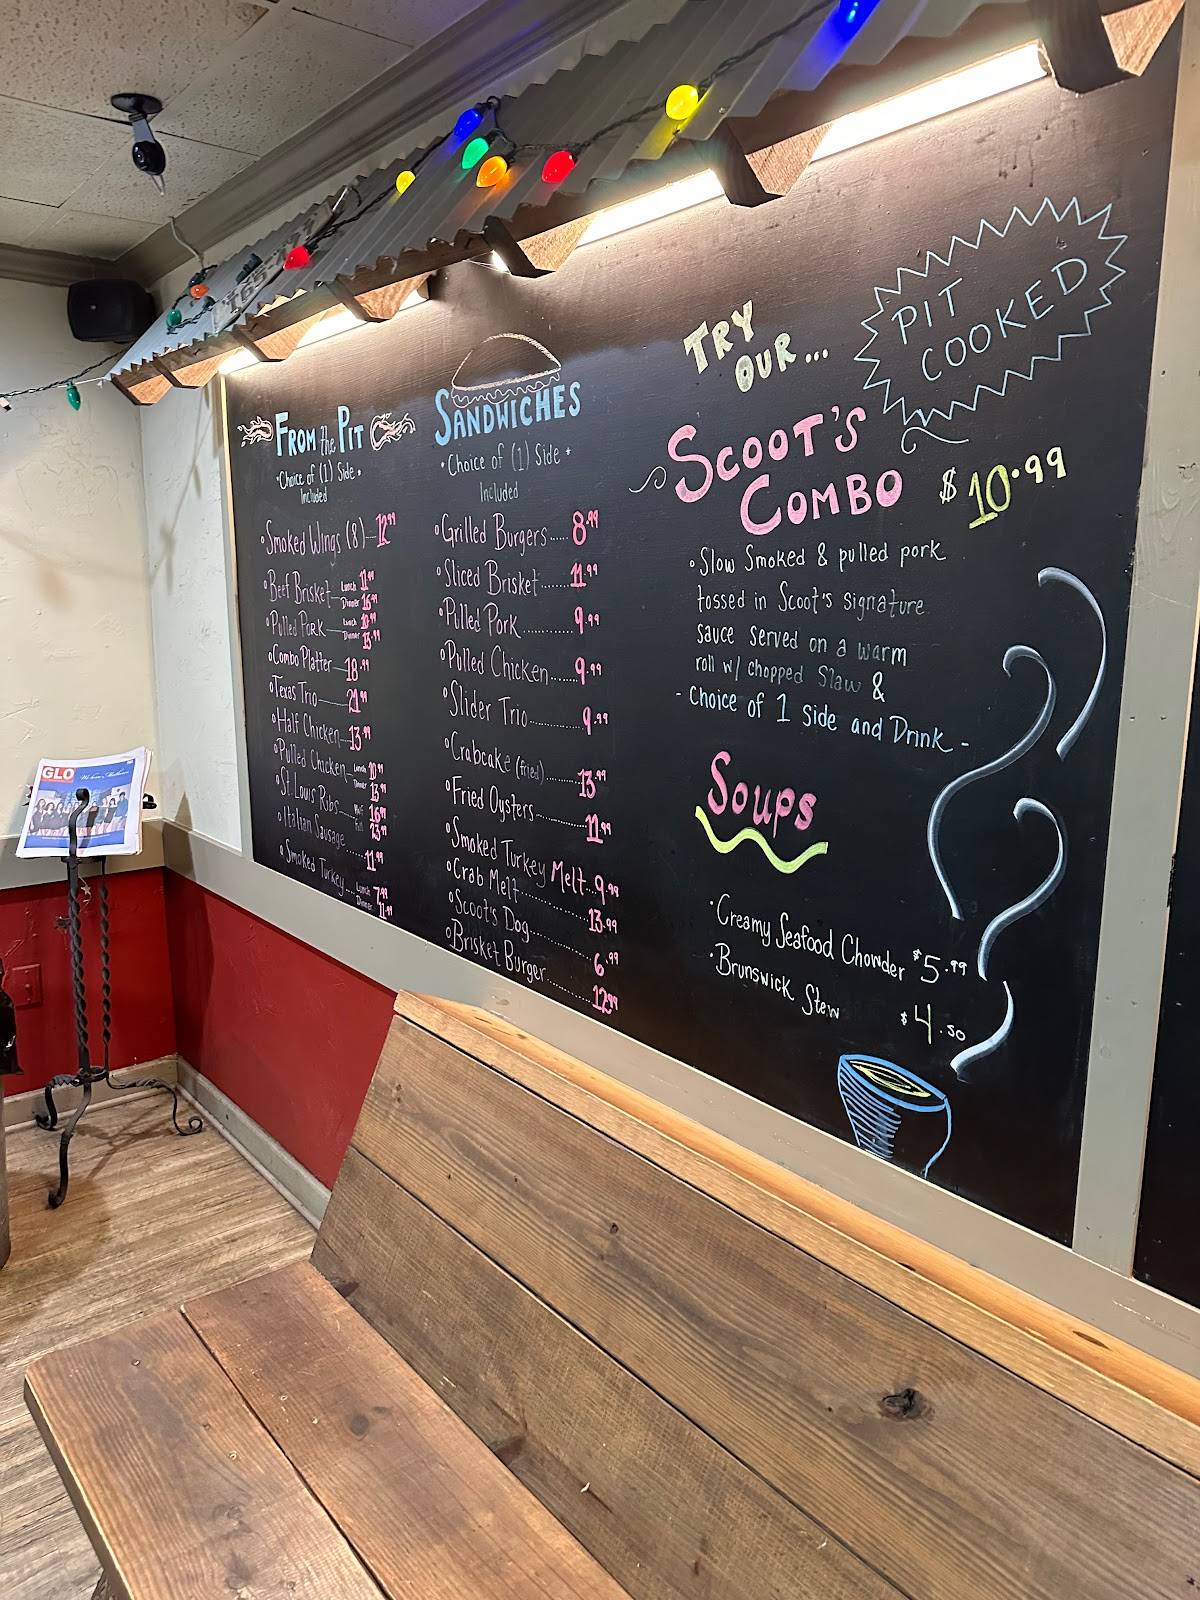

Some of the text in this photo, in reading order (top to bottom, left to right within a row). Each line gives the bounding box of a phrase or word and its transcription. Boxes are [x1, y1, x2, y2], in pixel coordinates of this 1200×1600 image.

[891, 277, 963, 345] PIT
[921, 257, 1088, 381] COOKED
[683, 299, 755, 375] TRY
[434, 381, 581, 447] SANDWICHES
[320, 425, 336, 456] the
[447, 440, 561, 477] Choice of (1) Side
[279, 459, 356, 490] Choice of (1) Side
[300, 486, 328, 504] Included
[479, 481, 519, 503] Included
[740, 469, 903, 535] COMBO
[266, 519, 306, 556] Smoked
[345, 516, 366, 550] (8)
[441, 512, 487, 549] Grilled
[492, 512, 549, 557] Burgers
[443, 558, 481, 588] Sliced
[484, 559, 540, 597] Brisket
[699, 539, 947, 576] Slow Smoked & pulled pork
[267, 568, 290, 602] Beef
[292, 570, 332, 609] Brisket
[697, 584, 746, 613] tossed
[754, 591, 767, 611] in
[778, 580, 833, 615] Scoot's
[269, 609, 297, 637] Pulled
[442, 596, 481, 633] Pulled
[482, 602, 522, 639] Pork
[272, 643, 300, 667] Combo
[300, 645, 332, 673] Platter
[443, 639, 485, 676] Pulled
[490, 644, 549, 686] Chicken
[808, 636, 828, 653] on
[836, 637, 848, 658] a
[857, 641, 907, 667] warm
[271, 674, 297, 701] Texas
[297, 681, 318, 707] Trio
[695, 654, 715, 673] roll
[722, 656, 741, 681] w/
[747, 657, 804, 685] chopped
[871, 670, 886, 703] &
[449, 679, 492, 721] Slider
[497, 696, 528, 728] Trio
[689, 684, 737, 713] Choice
[747, 692, 765, 719] of
[776, 693, 791, 723] 1
[851, 717, 883, 742] and
[889, 715, 954, 753] Drink
[276, 706, 300, 734] Half
[303, 712, 341, 748] Chicken
[42, 766, 75, 780] GLO
[276, 737, 306, 768] Pulled
[310, 748, 348, 783] Chicken
[450, 730, 512, 774] Crabcake
[515, 755, 545, 785] (fried)
[294, 771, 316, 804] Louis
[318, 784, 340, 815] Ribs
[451, 775, 485, 810] Fried
[489, 785, 534, 823] Oysters
[708, 750, 818, 839] Soups
[283, 805, 313, 834] Italian
[314, 813, 346, 850] Sausage
[285, 838, 316, 873] Smoked
[319, 857, 345, 897] Turkey
[451, 815, 498, 860] Smoked
[500, 839, 546, 889] Turkey
[550, 860, 587, 896] Melt
[453, 857, 484, 887] Crab
[489, 868, 520, 904] Melt
[502, 905, 531, 944] Dog
[716, 893, 771, 947] Creamy
[775, 912, 835, 961] Seafood
[841, 933, 906, 982] Chowder
[449, 917, 501, 967] Brisket
[503, 939, 547, 984] Burger
[714, 942, 795, 1001] Brunswick
[801, 983, 840, 1020] Stew
